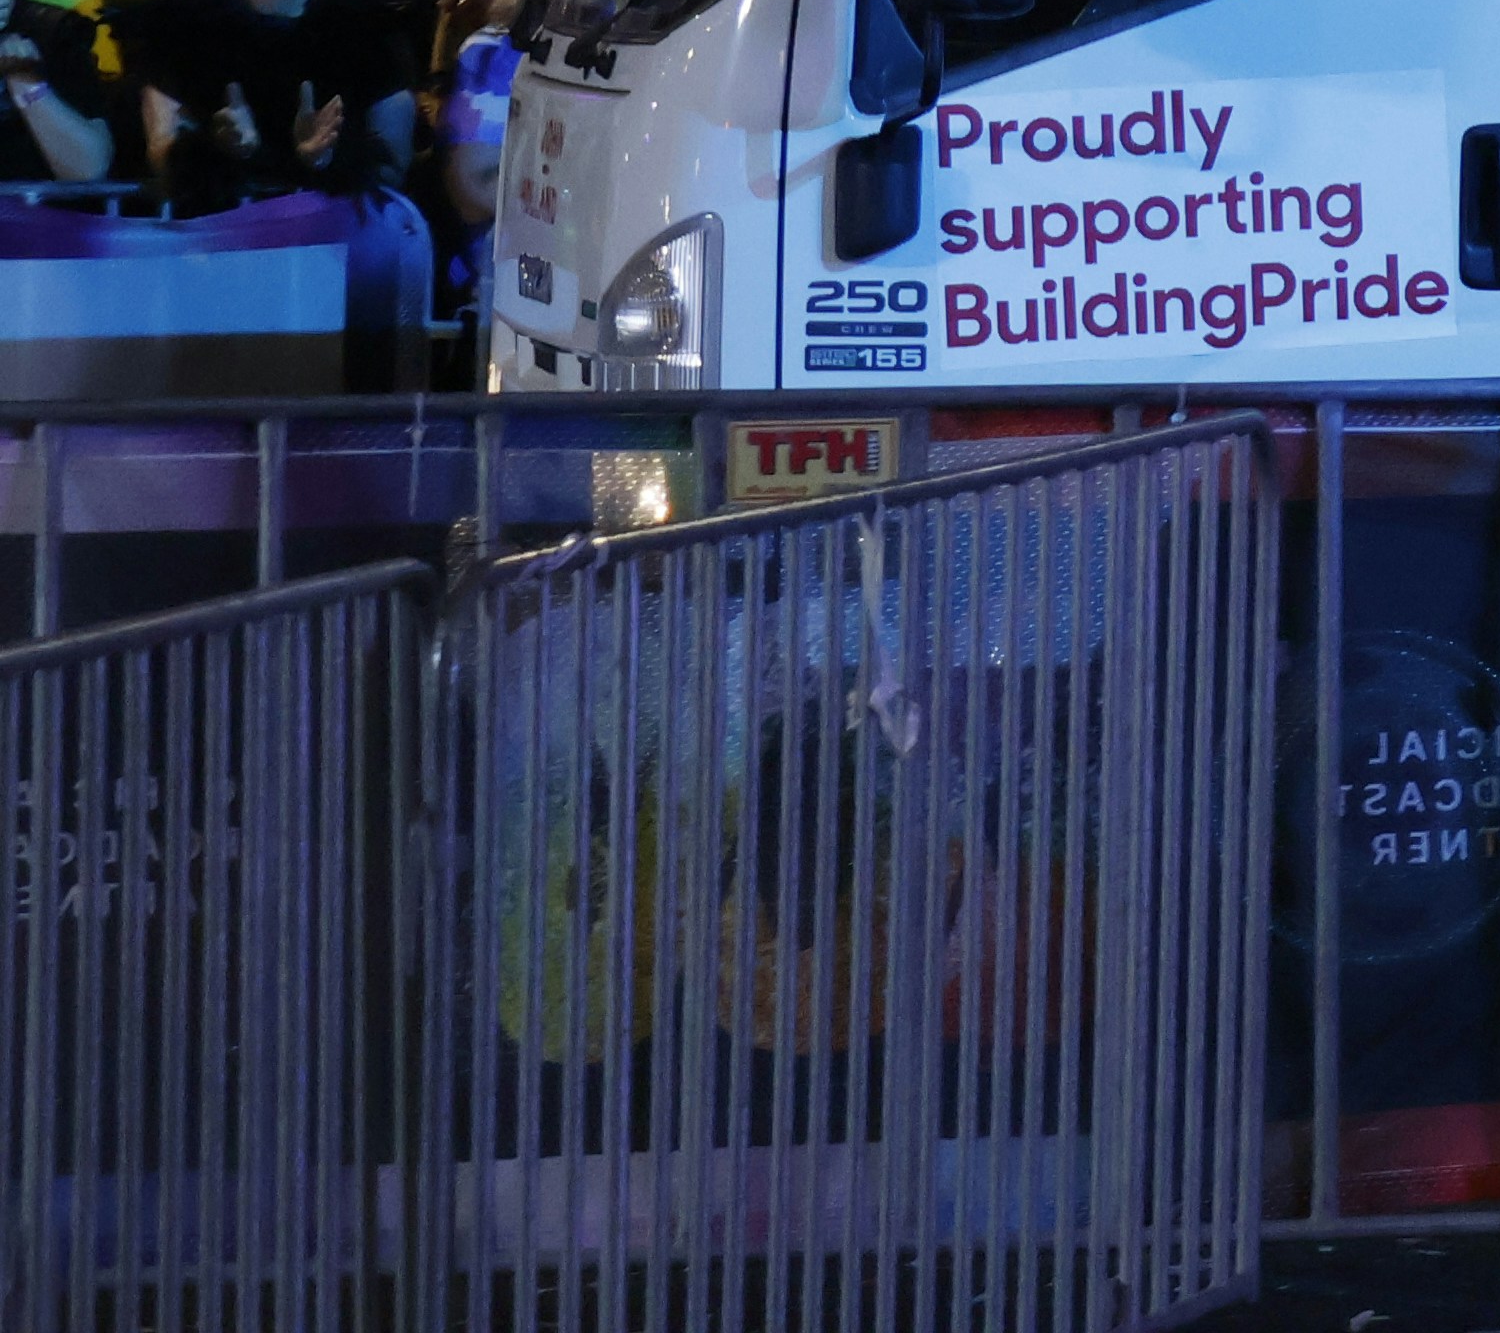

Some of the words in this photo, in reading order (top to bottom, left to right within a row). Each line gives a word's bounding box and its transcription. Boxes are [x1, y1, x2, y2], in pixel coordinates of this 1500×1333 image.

[936, 89, 1234, 171] Proudly
[940, 171, 1363, 269] supporting
[806, 280, 929, 314] 250
[944, 254, 1451, 349] BuildingPride
[857, 347, 922, 368] 155
[747, 429, 868, 475] TFH
